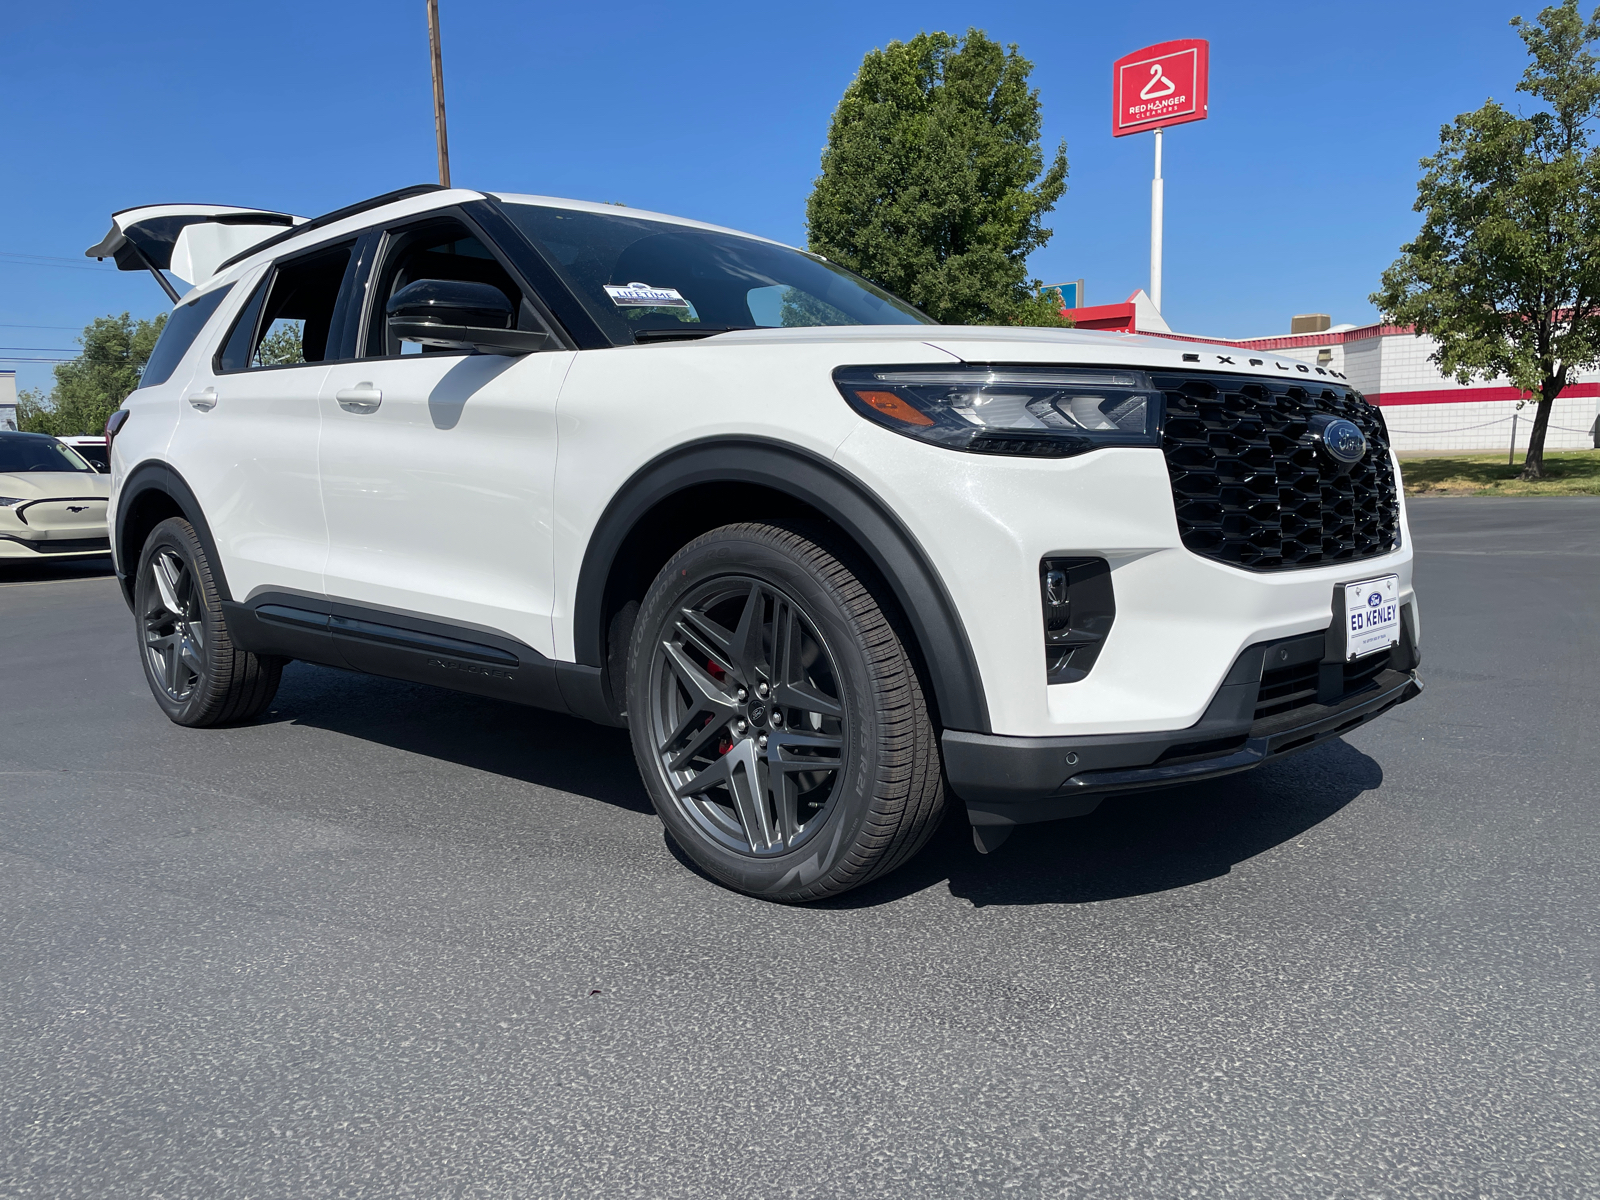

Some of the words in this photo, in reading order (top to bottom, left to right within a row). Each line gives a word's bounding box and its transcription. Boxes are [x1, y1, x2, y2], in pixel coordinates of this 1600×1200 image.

[1129, 104, 1146, 114] RED
[1147, 95, 1186, 110] HANGER
[1136, 105, 1178, 119] CLEANERS
[616, 290, 673, 299] LIFETIME
[1337, 428, 1362, 451] Ford
[631, 568, 678, 674] SCORPION
[1351, 613, 1364, 631] ED
[1366, 604, 1397, 628] KENLEY
[427, 658, 515, 681] EXPLORER
[855, 754, 869, 797] R21
